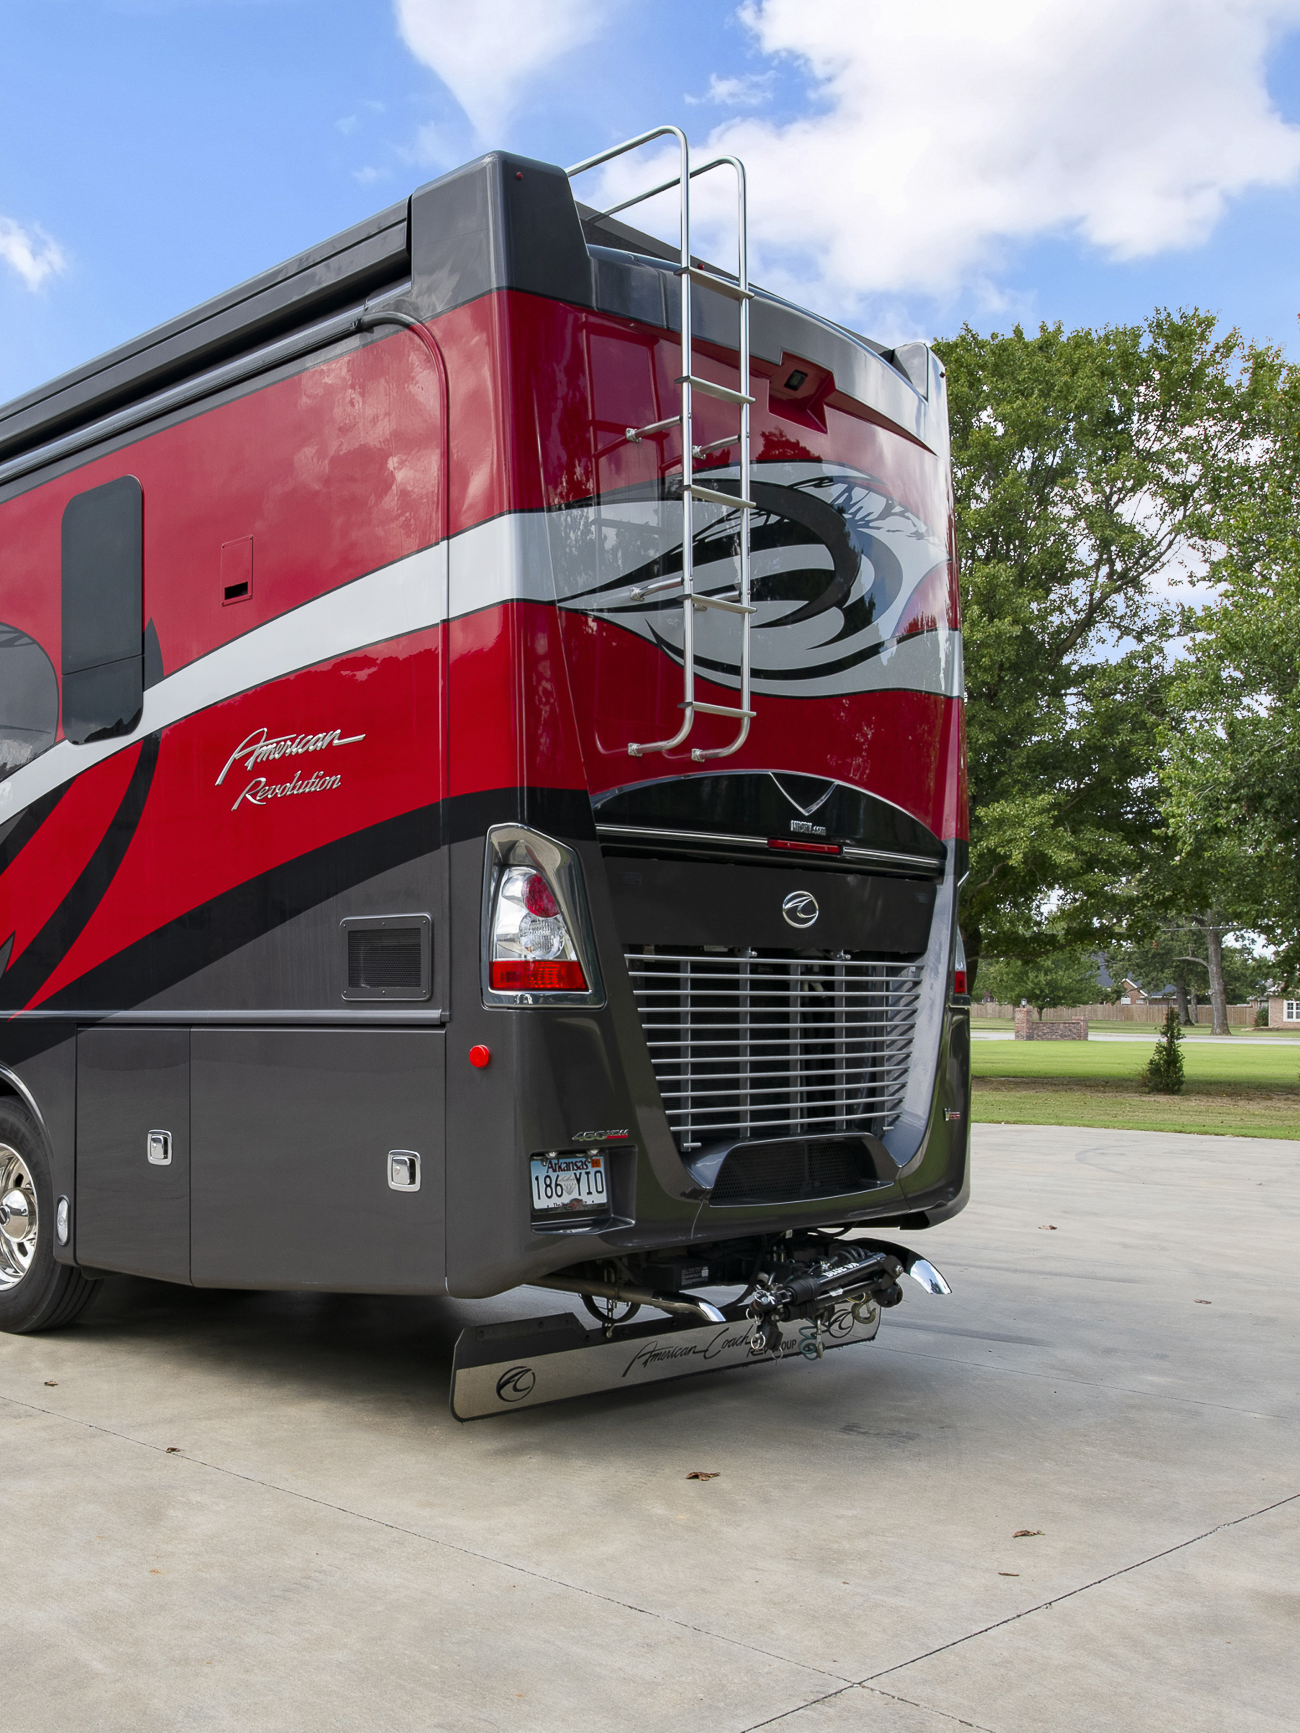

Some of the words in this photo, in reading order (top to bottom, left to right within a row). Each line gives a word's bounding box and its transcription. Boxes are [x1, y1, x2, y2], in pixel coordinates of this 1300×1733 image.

[215, 727, 366, 786] American
[231, 770, 342, 812] Revolution
[534, 1174, 564, 1201] 186
[546, 1160, 589, 1174] Arkansas
[622, 1340, 701, 1378] American
[703, 1324, 756, 1360] Coach
